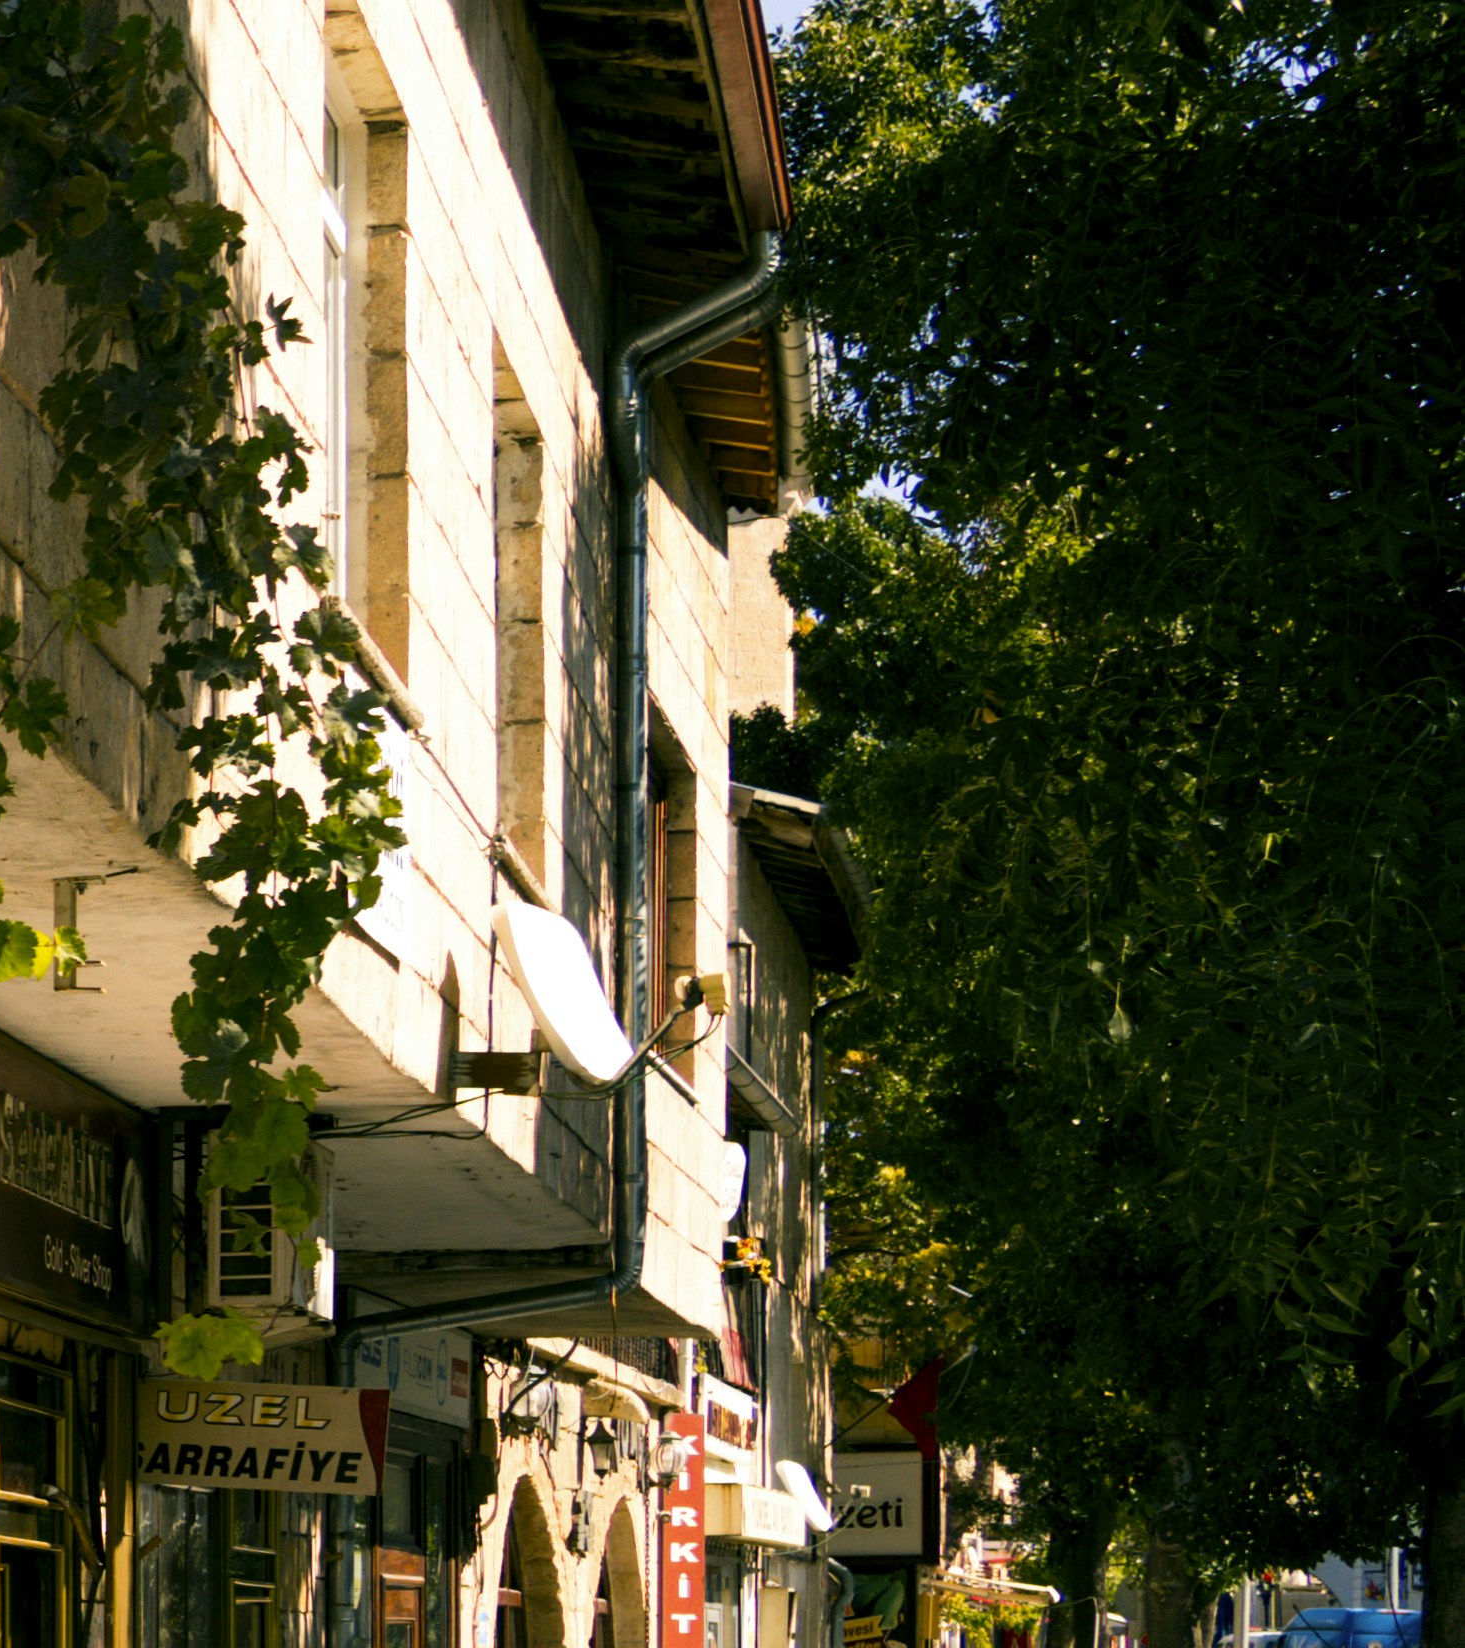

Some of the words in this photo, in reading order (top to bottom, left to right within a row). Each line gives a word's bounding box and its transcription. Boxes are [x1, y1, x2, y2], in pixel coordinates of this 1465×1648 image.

[44, 1234, 63, 1274] Gold
[92, 1252, 113, 1300] Shop
[156, 1389, 332, 1430] UZEL
[835, 1497, 904, 1529] zeti
